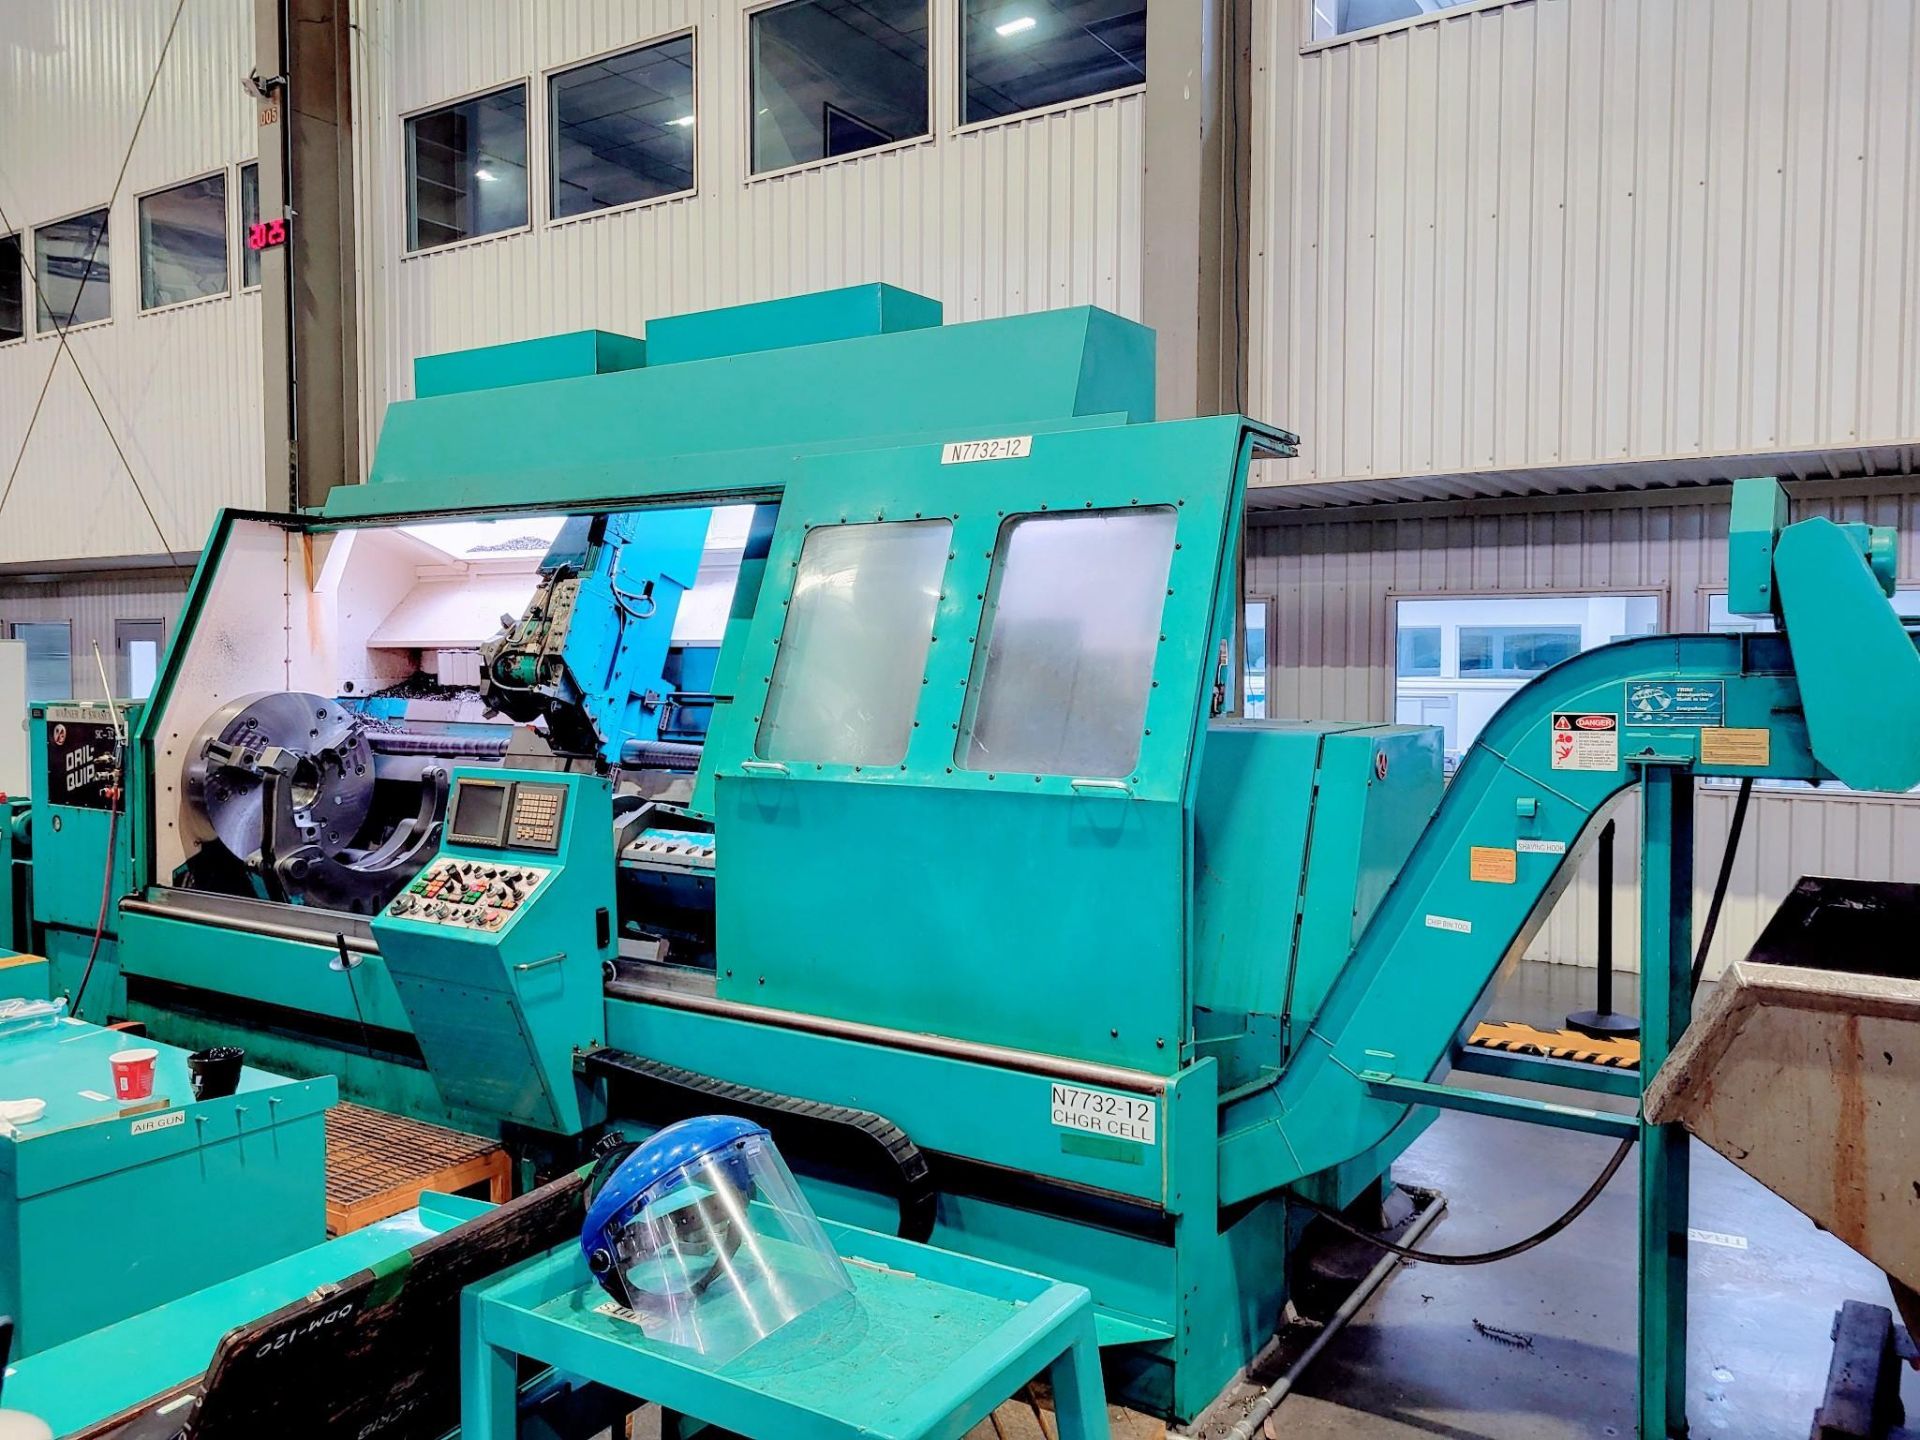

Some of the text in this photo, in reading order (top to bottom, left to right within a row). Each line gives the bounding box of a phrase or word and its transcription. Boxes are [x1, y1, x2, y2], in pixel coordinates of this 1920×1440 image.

[952, 439, 1021, 461] N7732-12
[1578, 719, 1612, 727] DANGER
[1546, 843, 1565, 853] HOOK
[1053, 1086, 1149, 1123] N7732-12
[133, 1114, 184, 1133] AIR GUN
[1053, 1108, 1151, 1141] CHGR CELL
